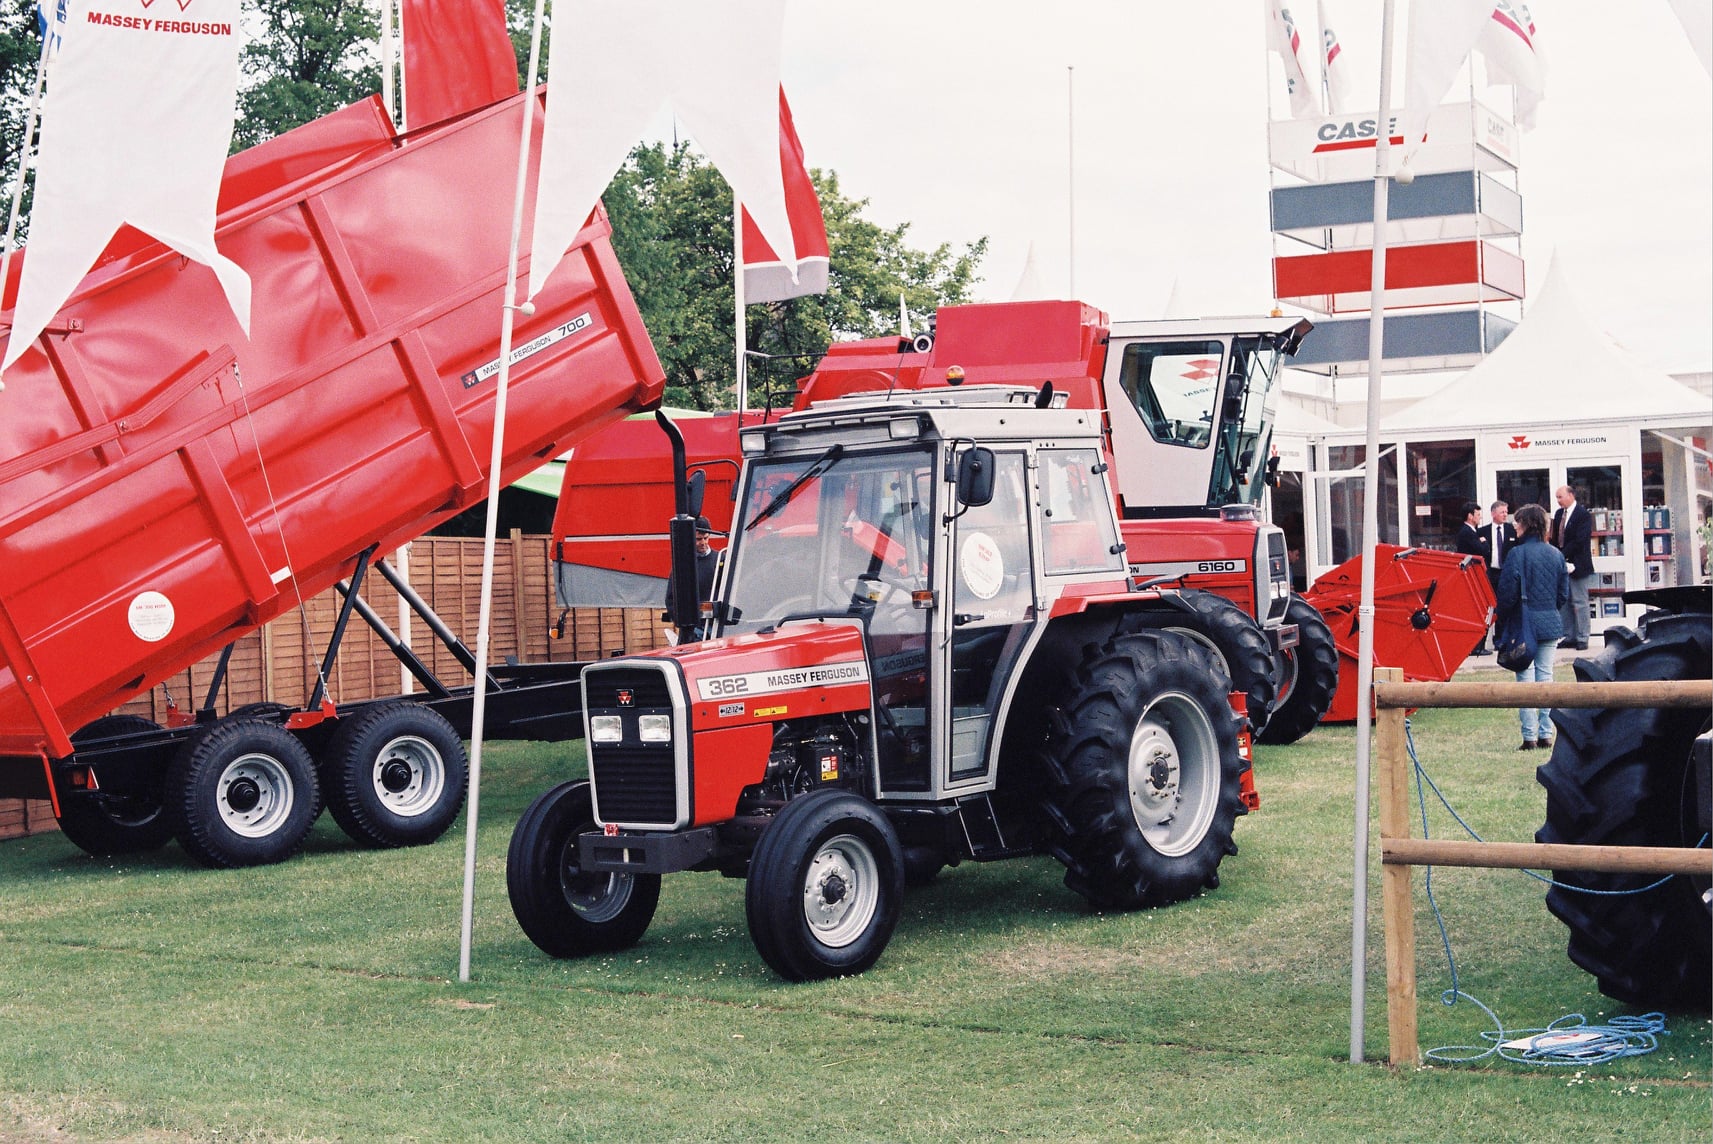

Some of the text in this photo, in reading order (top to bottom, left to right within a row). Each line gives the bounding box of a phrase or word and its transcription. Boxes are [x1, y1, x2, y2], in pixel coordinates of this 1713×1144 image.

[87, 12, 152, 31] MASSEY
[154, 20, 232, 36] FERGUSON
[482, 317, 586, 376] MAS FERGUSON 700
[1534, 437, 1607, 447] MASSEY FERGUSON
[1198, 561, 1235, 572] 6160
[709, 666, 860, 696] 362 MASSEY FERGUSON
